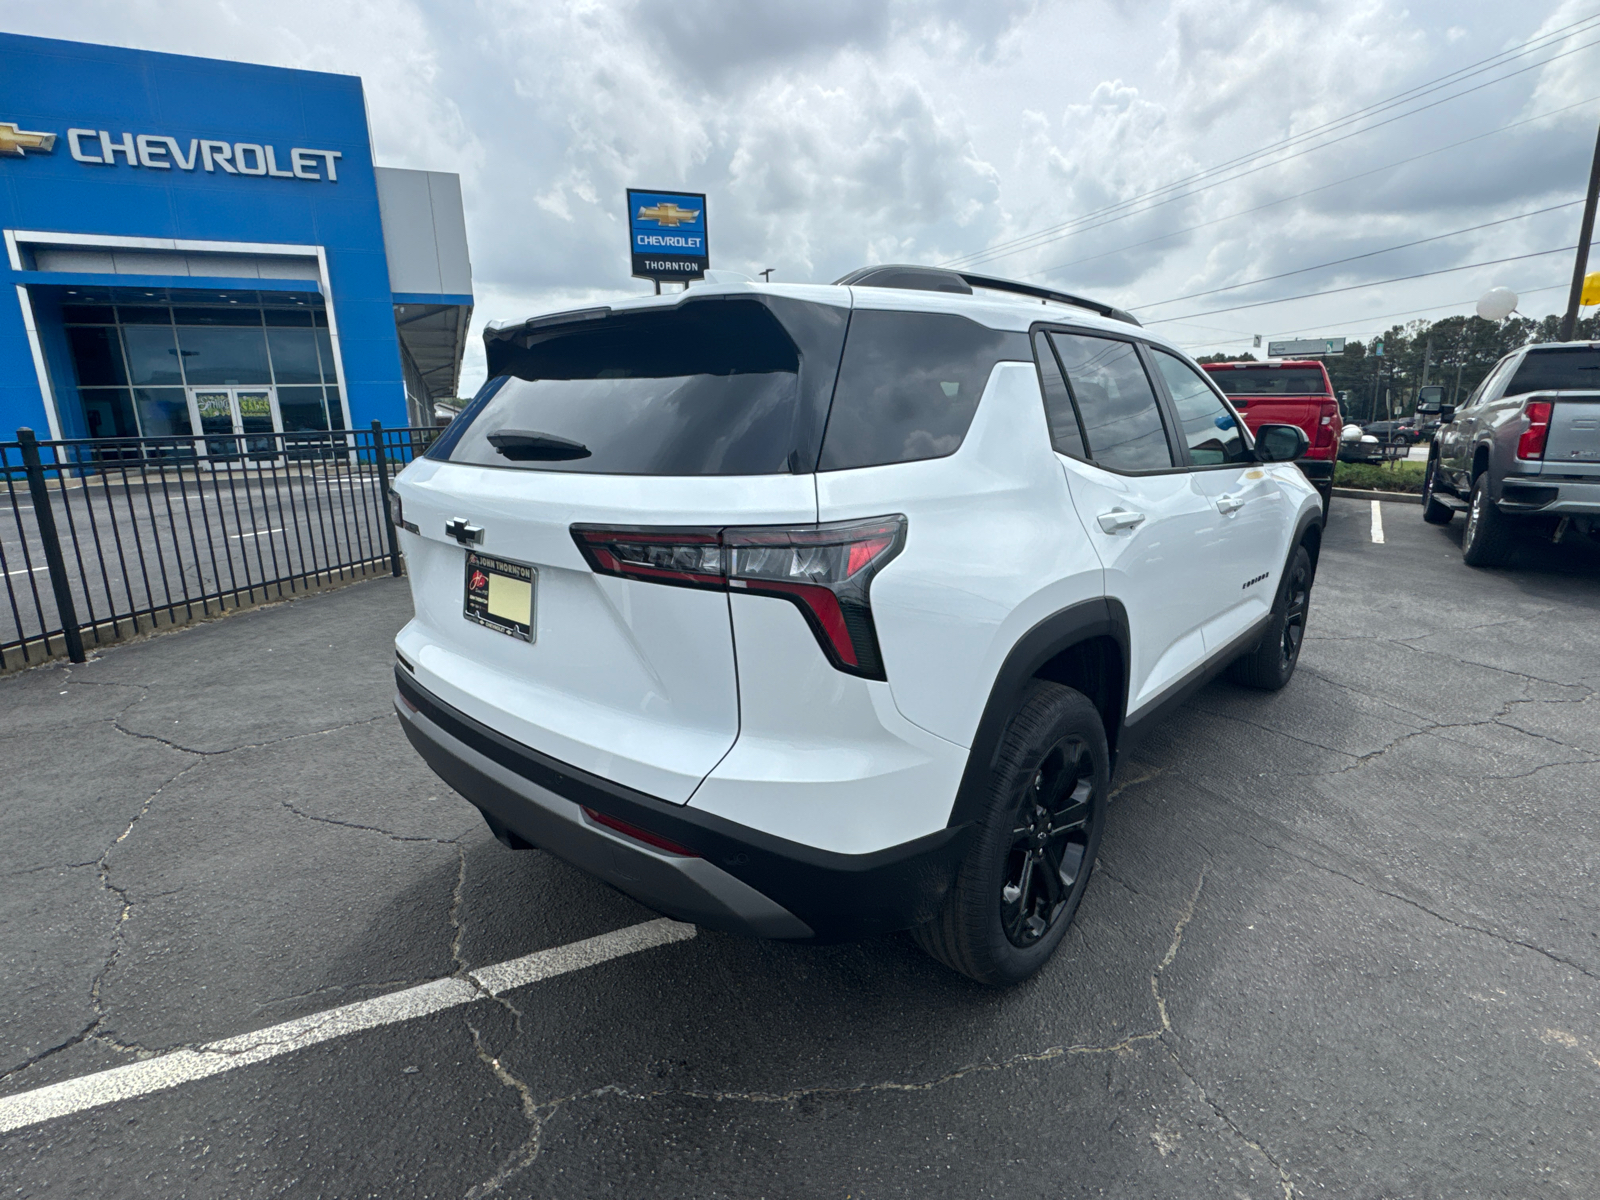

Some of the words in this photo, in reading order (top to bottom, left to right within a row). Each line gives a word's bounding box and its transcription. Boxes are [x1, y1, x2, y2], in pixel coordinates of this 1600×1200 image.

[67, 128, 342, 182] CHEVROLET
[637, 235, 701, 247] CHEVROLET
[645, 261, 698, 271] THORNTON
[480, 557, 495, 568] JOHN
[496, 561, 530, 578] THORNTON
